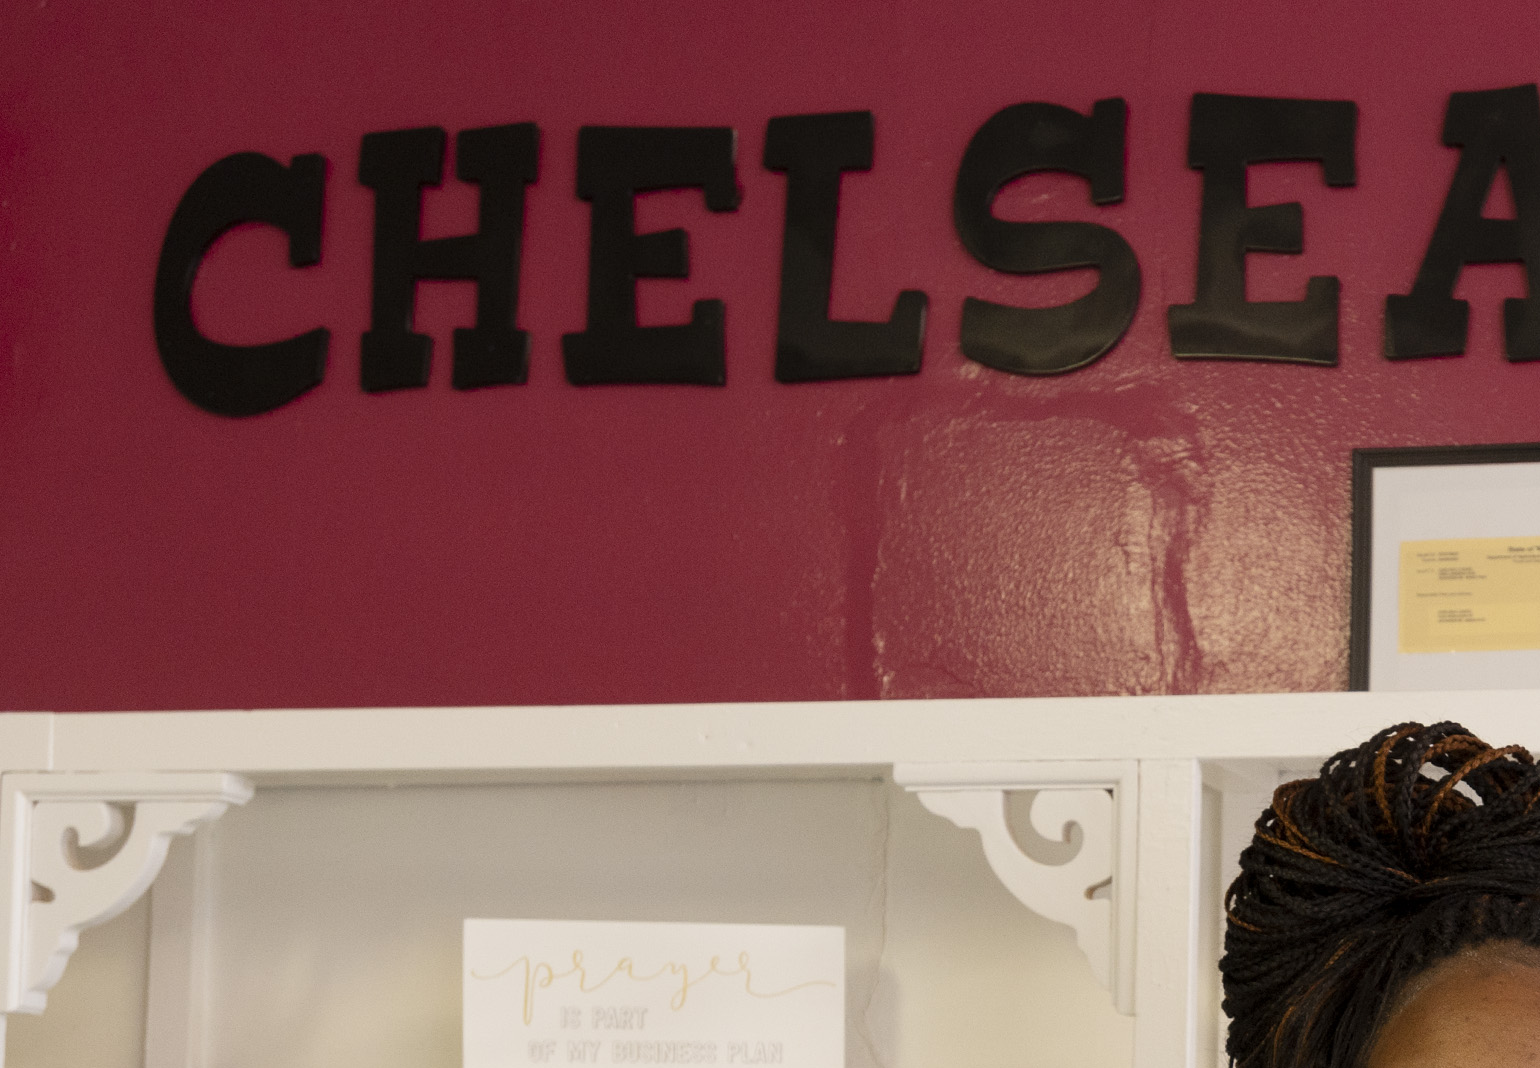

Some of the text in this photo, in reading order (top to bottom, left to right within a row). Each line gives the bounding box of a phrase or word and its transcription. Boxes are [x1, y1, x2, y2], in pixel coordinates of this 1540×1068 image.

[470, 949, 837, 1026] prayer
[559, 1006, 648, 1030] IS PART
[527, 1041, 784, 1064] OF MY BUSINESS PLAN
